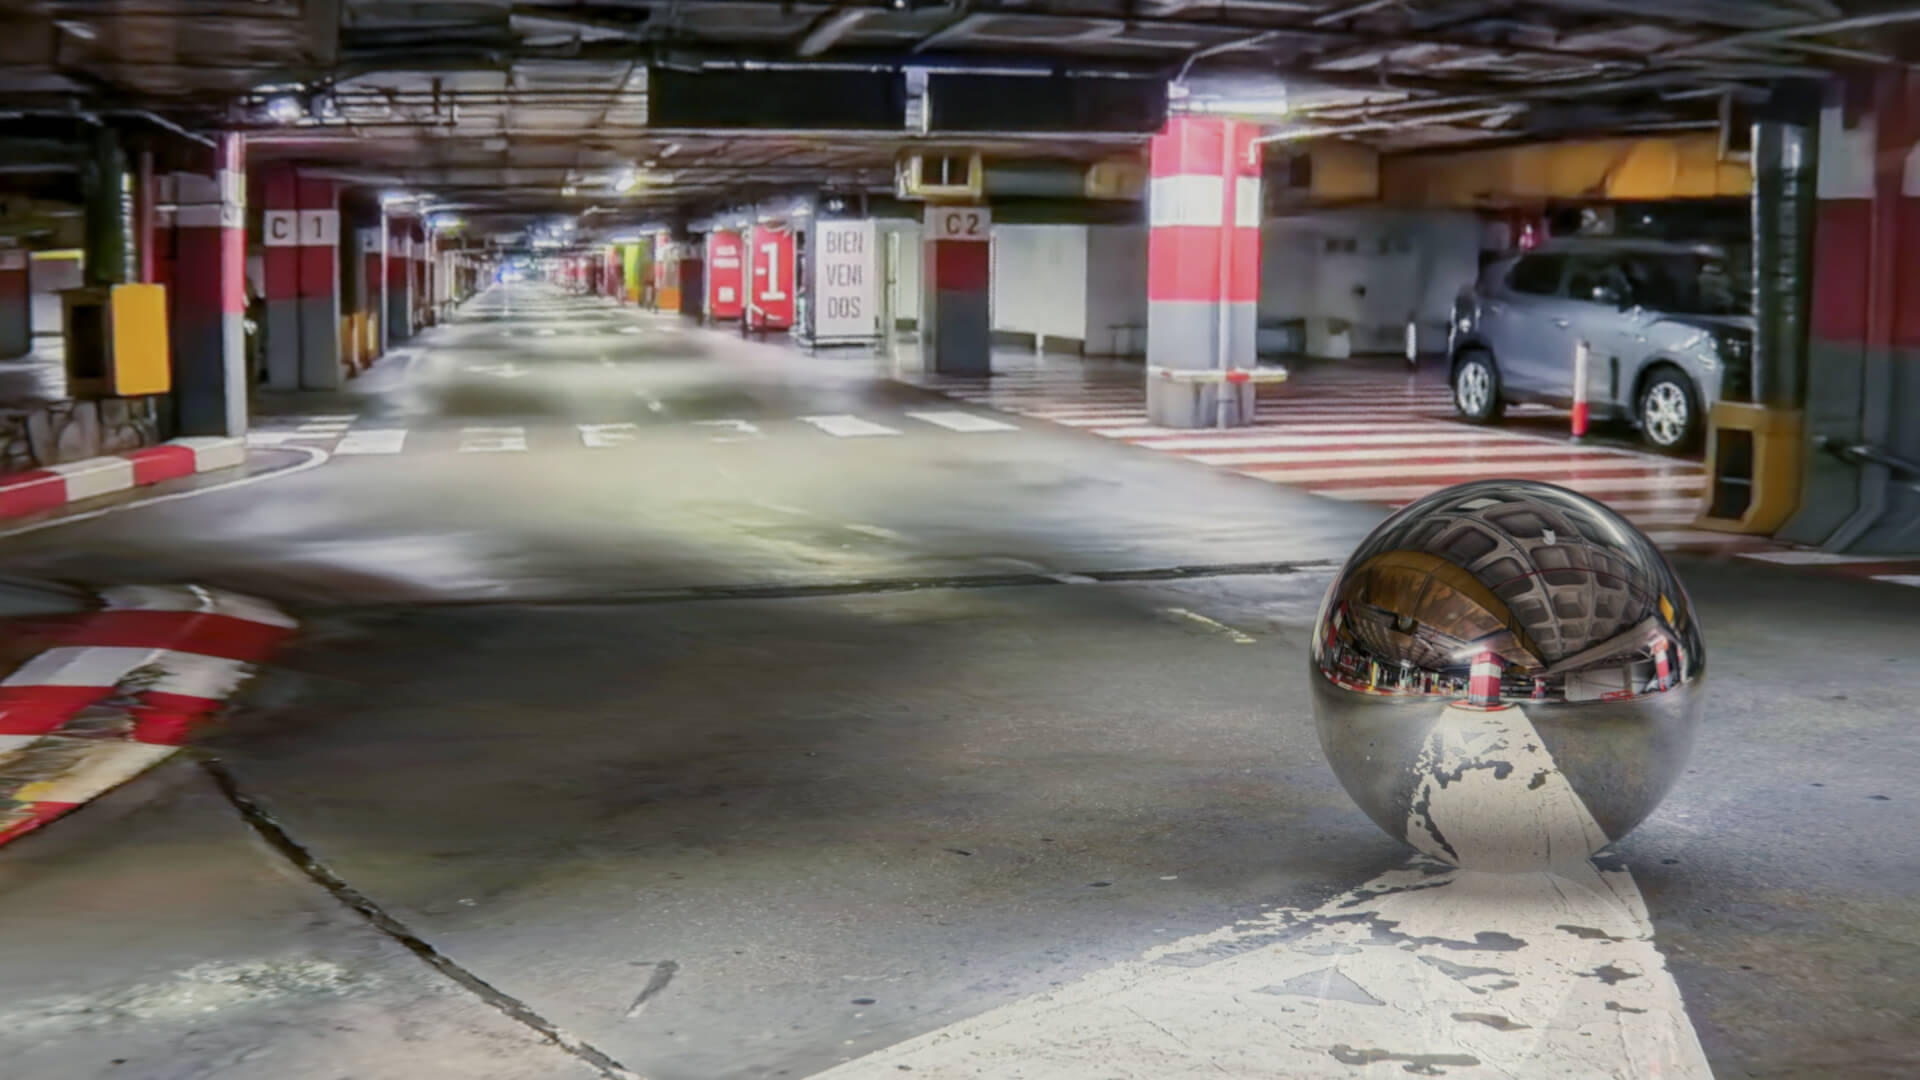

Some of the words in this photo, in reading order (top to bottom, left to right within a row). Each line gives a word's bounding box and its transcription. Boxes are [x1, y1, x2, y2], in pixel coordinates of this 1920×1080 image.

[272, 216, 288, 240] C
[312, 216, 322, 239] 1
[826, 231, 864, 254] BIEN
[755, 242, 786, 301] -1
[826, 264, 863, 287] VENI
[827, 296, 862, 319] DOS
